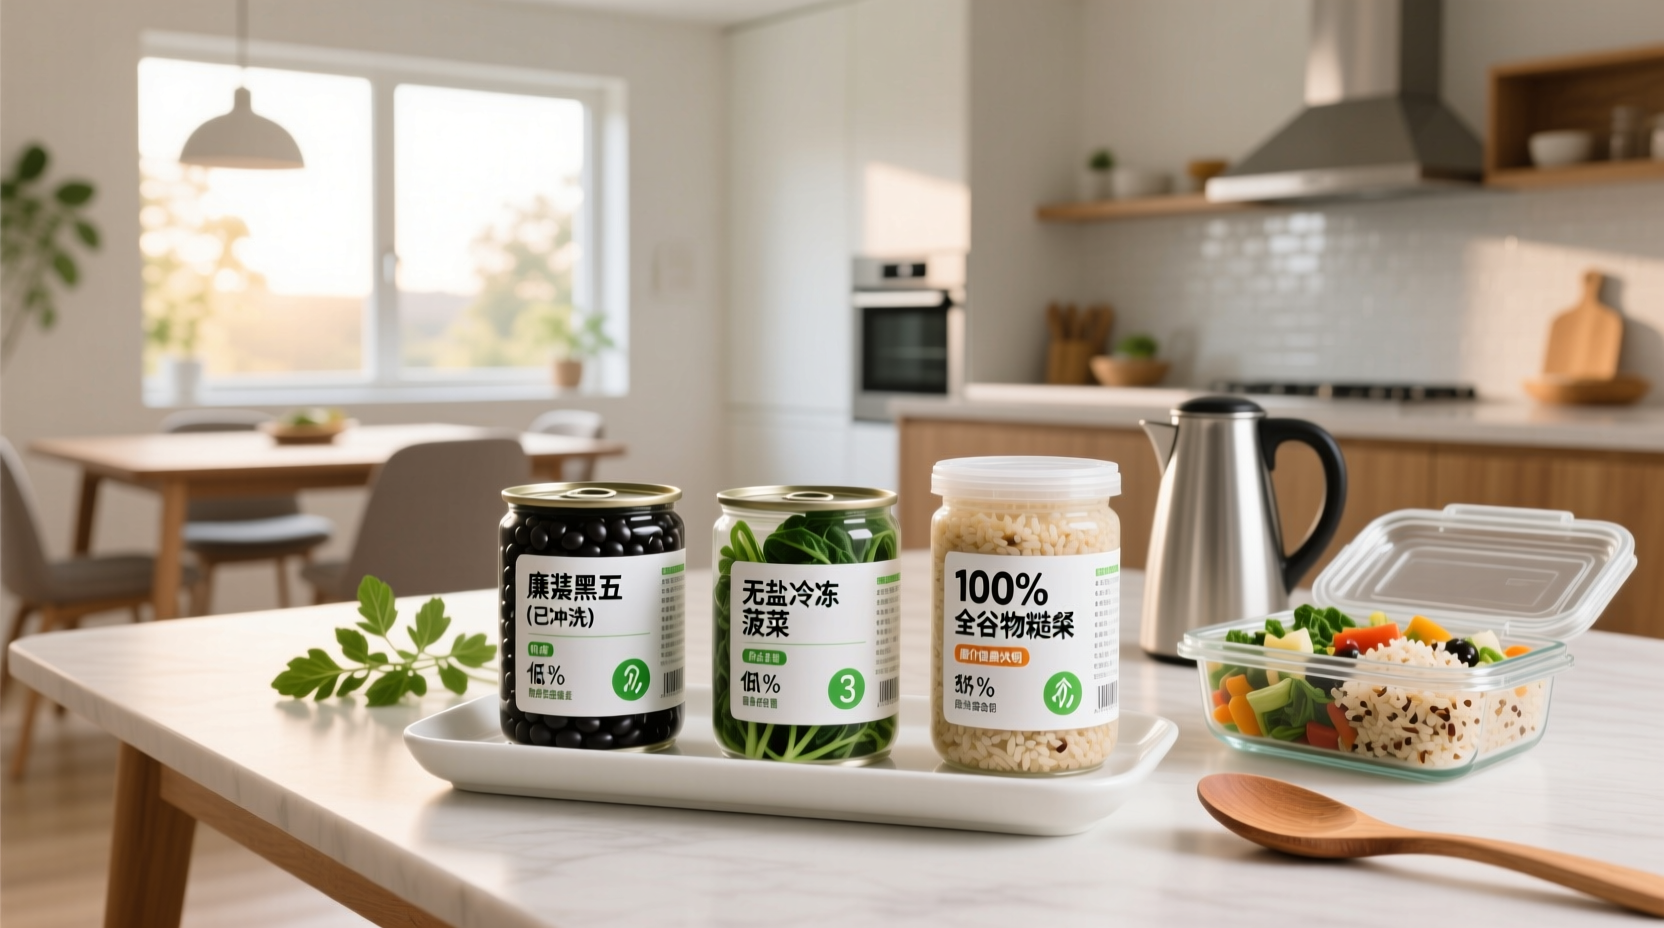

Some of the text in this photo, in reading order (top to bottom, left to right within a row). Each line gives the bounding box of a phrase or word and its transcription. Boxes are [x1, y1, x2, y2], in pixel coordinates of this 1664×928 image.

[742, 579, 839, 609] 无盐冷冻
[955, 569, 1048, 606] 100%
[742, 607, 790, 639] 菠菜
[839, 674, 856, 704] 3
